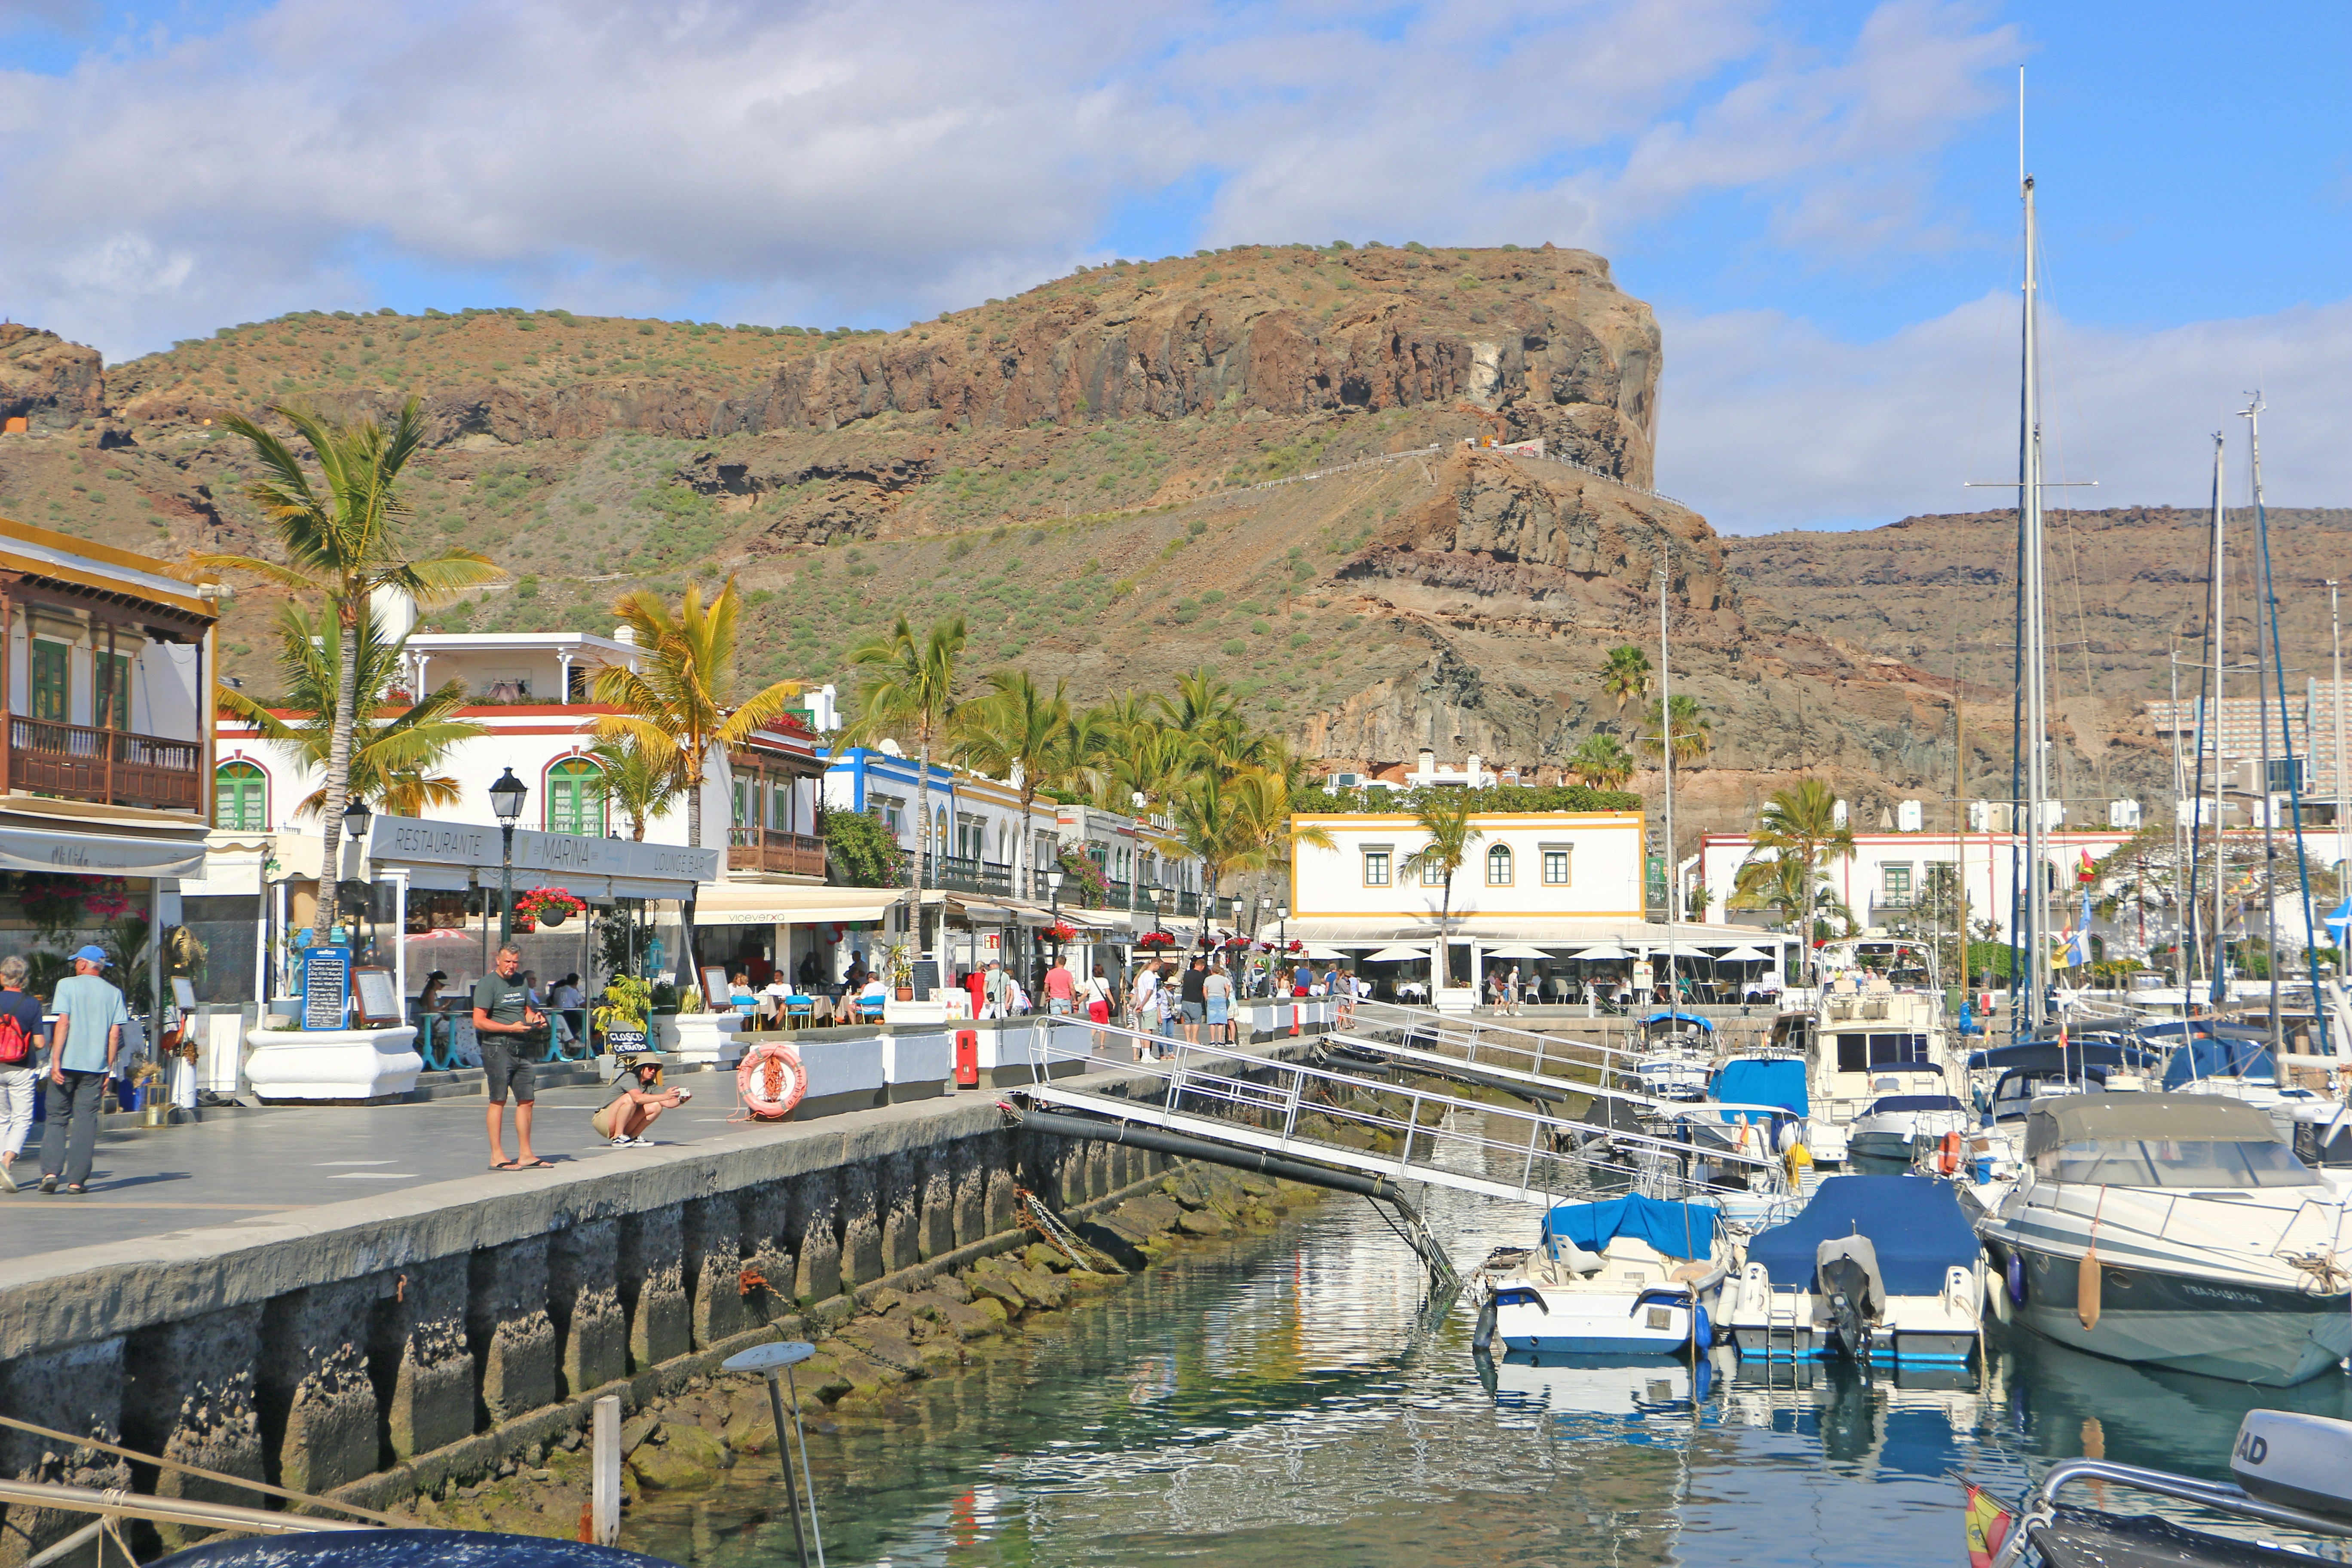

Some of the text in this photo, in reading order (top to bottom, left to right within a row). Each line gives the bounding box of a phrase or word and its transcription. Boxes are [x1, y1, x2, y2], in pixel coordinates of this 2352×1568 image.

[395, 828, 481, 856] RESTAURANTE
[541, 837, 588, 867] MARINA
[68, 845, 89, 870] Vida
[654, 853, 705, 873] LOUNGE BAR
[729, 914, 784, 922] viceverxa
[613, 1043, 647, 1052] CERRADO
